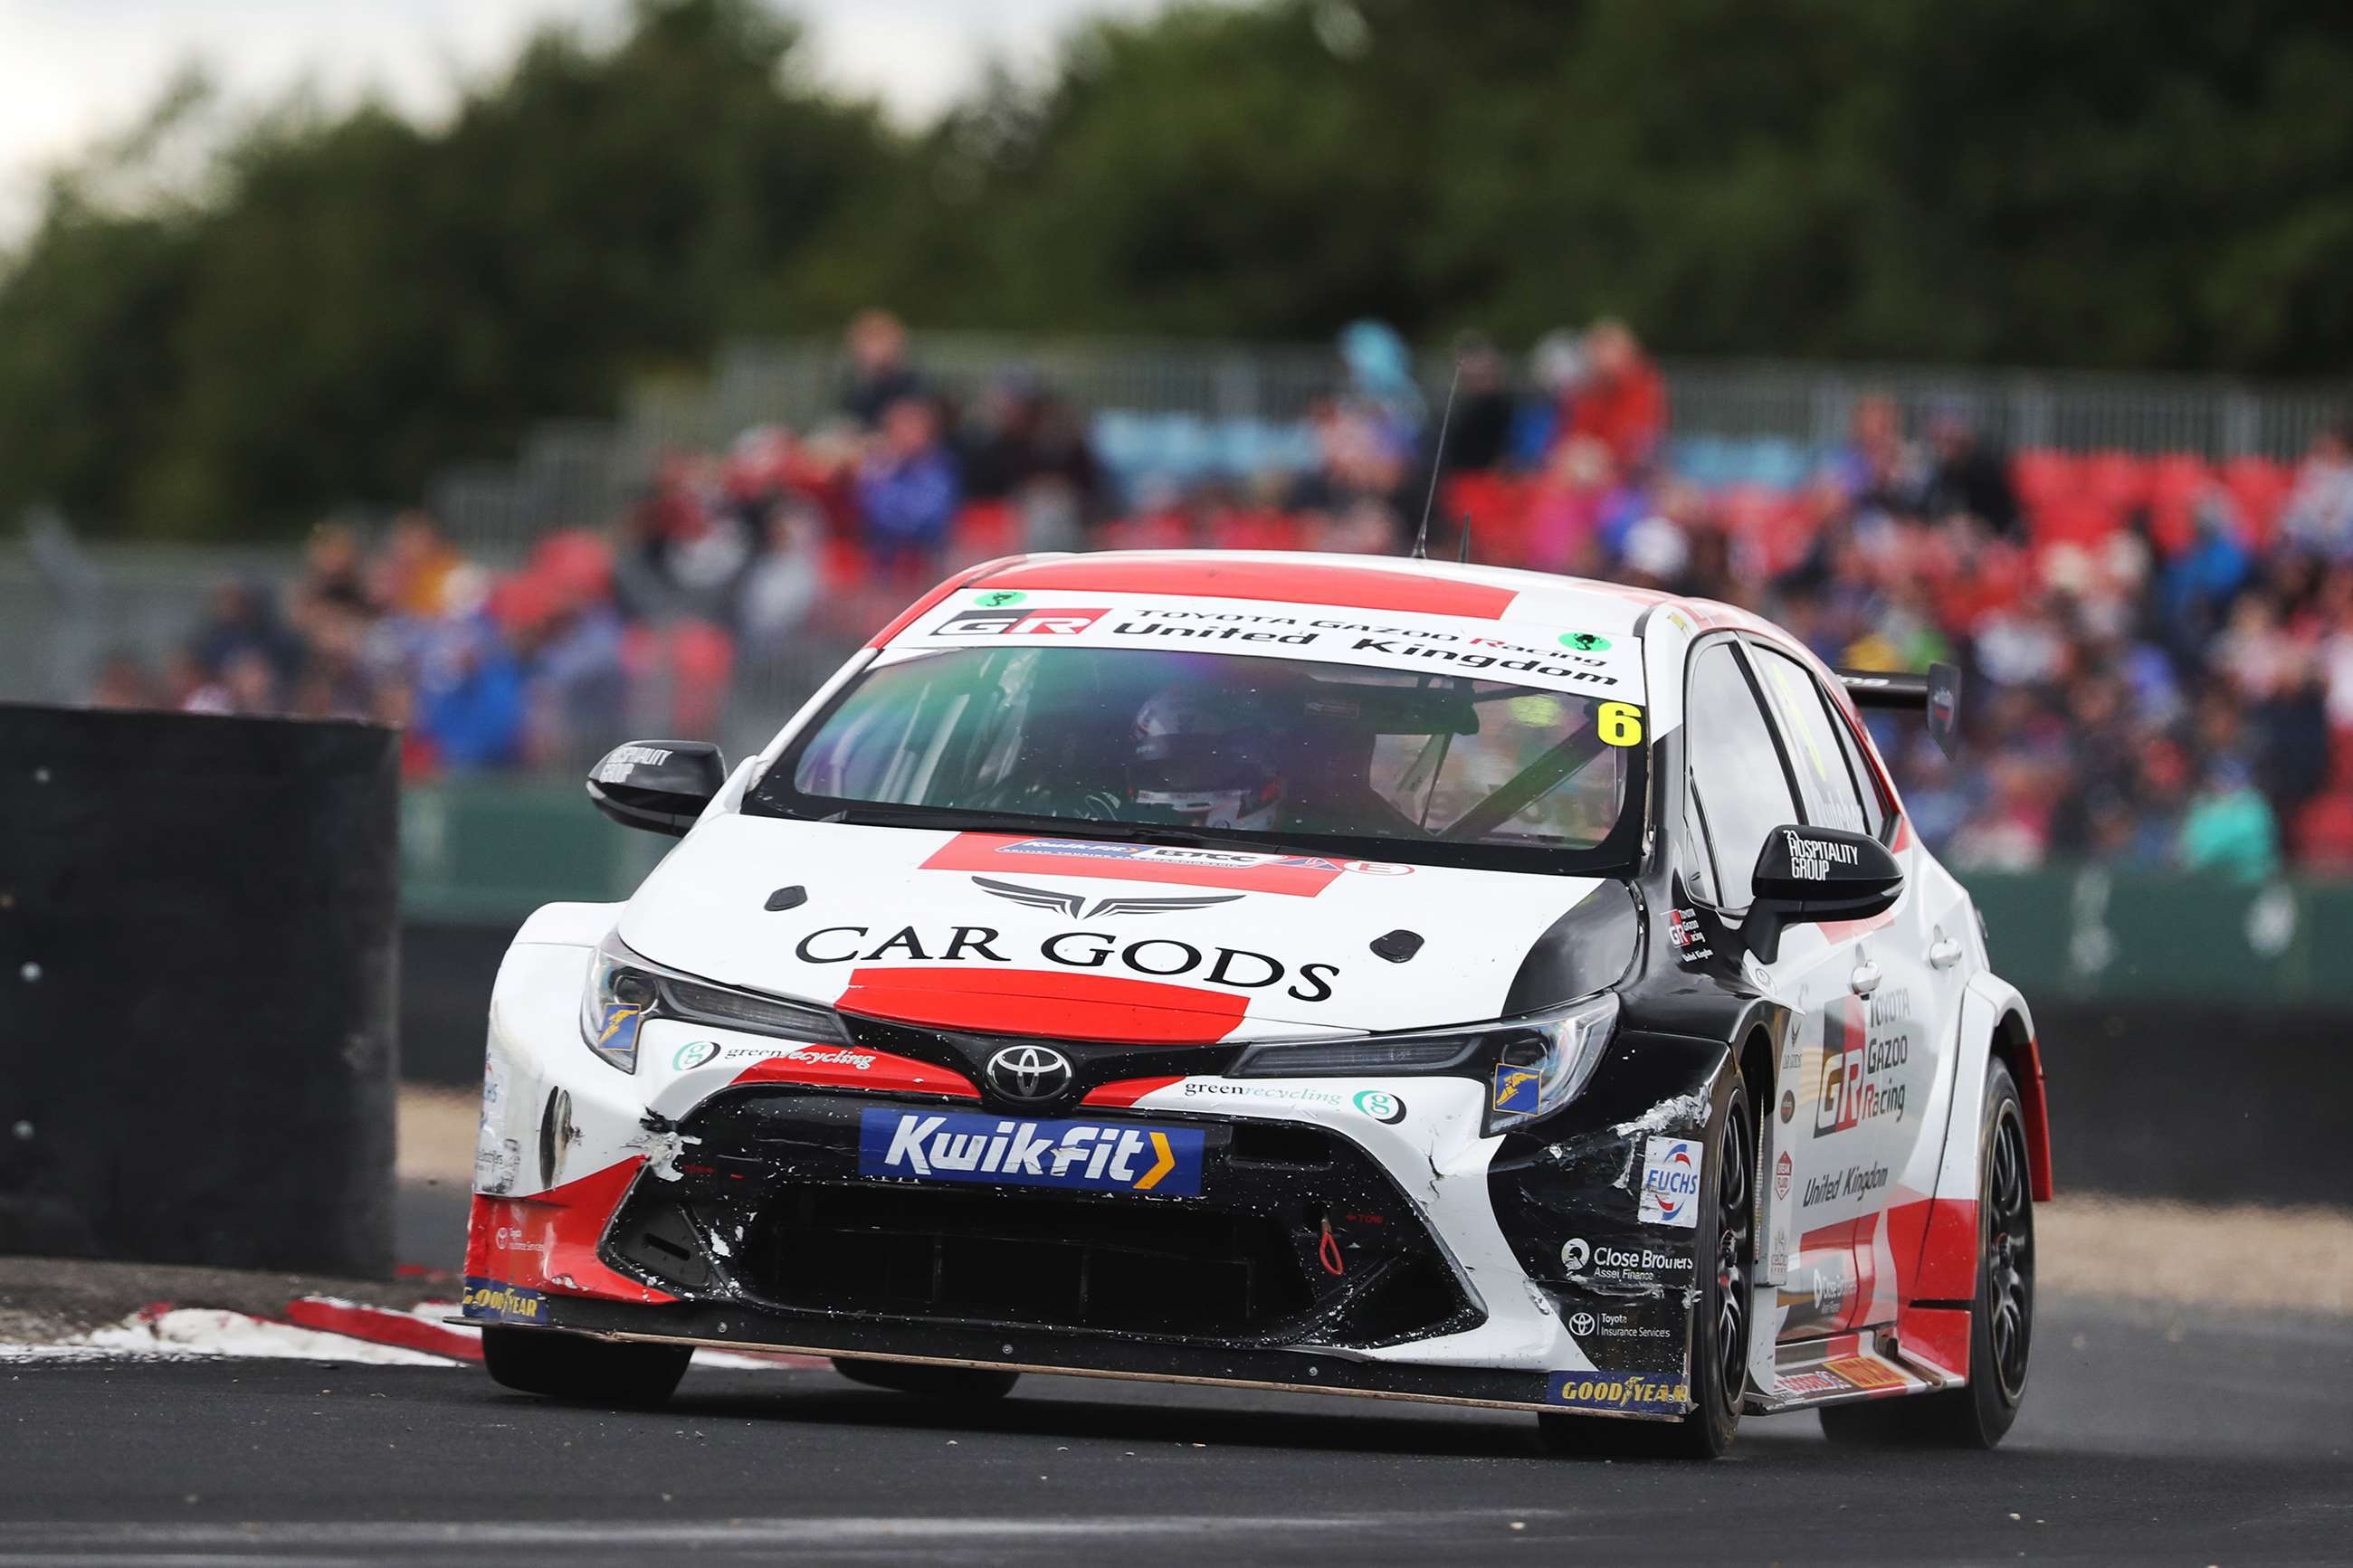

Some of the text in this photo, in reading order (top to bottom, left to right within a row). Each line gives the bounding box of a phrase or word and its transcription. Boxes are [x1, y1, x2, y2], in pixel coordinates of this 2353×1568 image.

[1112, 622, 1619, 686] United Kingdom
[1136, 609, 1607, 667] TOYOTA GAZOO Racing
[1597, 701, 1643, 746] 6
[1788, 838, 1858, 865] HOSPITALITY
[1791, 857, 1830, 881] GROUP
[795, 925, 1341, 1003] CAR GODS
[1869, 988, 1911, 1029] TOYOTA
[1867, 1035, 1909, 1075] GAZOO
[1862, 1078, 1906, 1123] Racing
[1647, 1169, 1698, 1195] FUCHS
[1802, 1161, 1889, 1208] United Kingdom
[1593, 1247, 1640, 1268] Close
[1621, 1269, 1654, 1281] Finance
[1601, 1313, 1628, 1326] Toyota
[1601, 1326, 1672, 1338] Insurance Services
[1561, 1379, 1690, 1404] GOODYEAR
